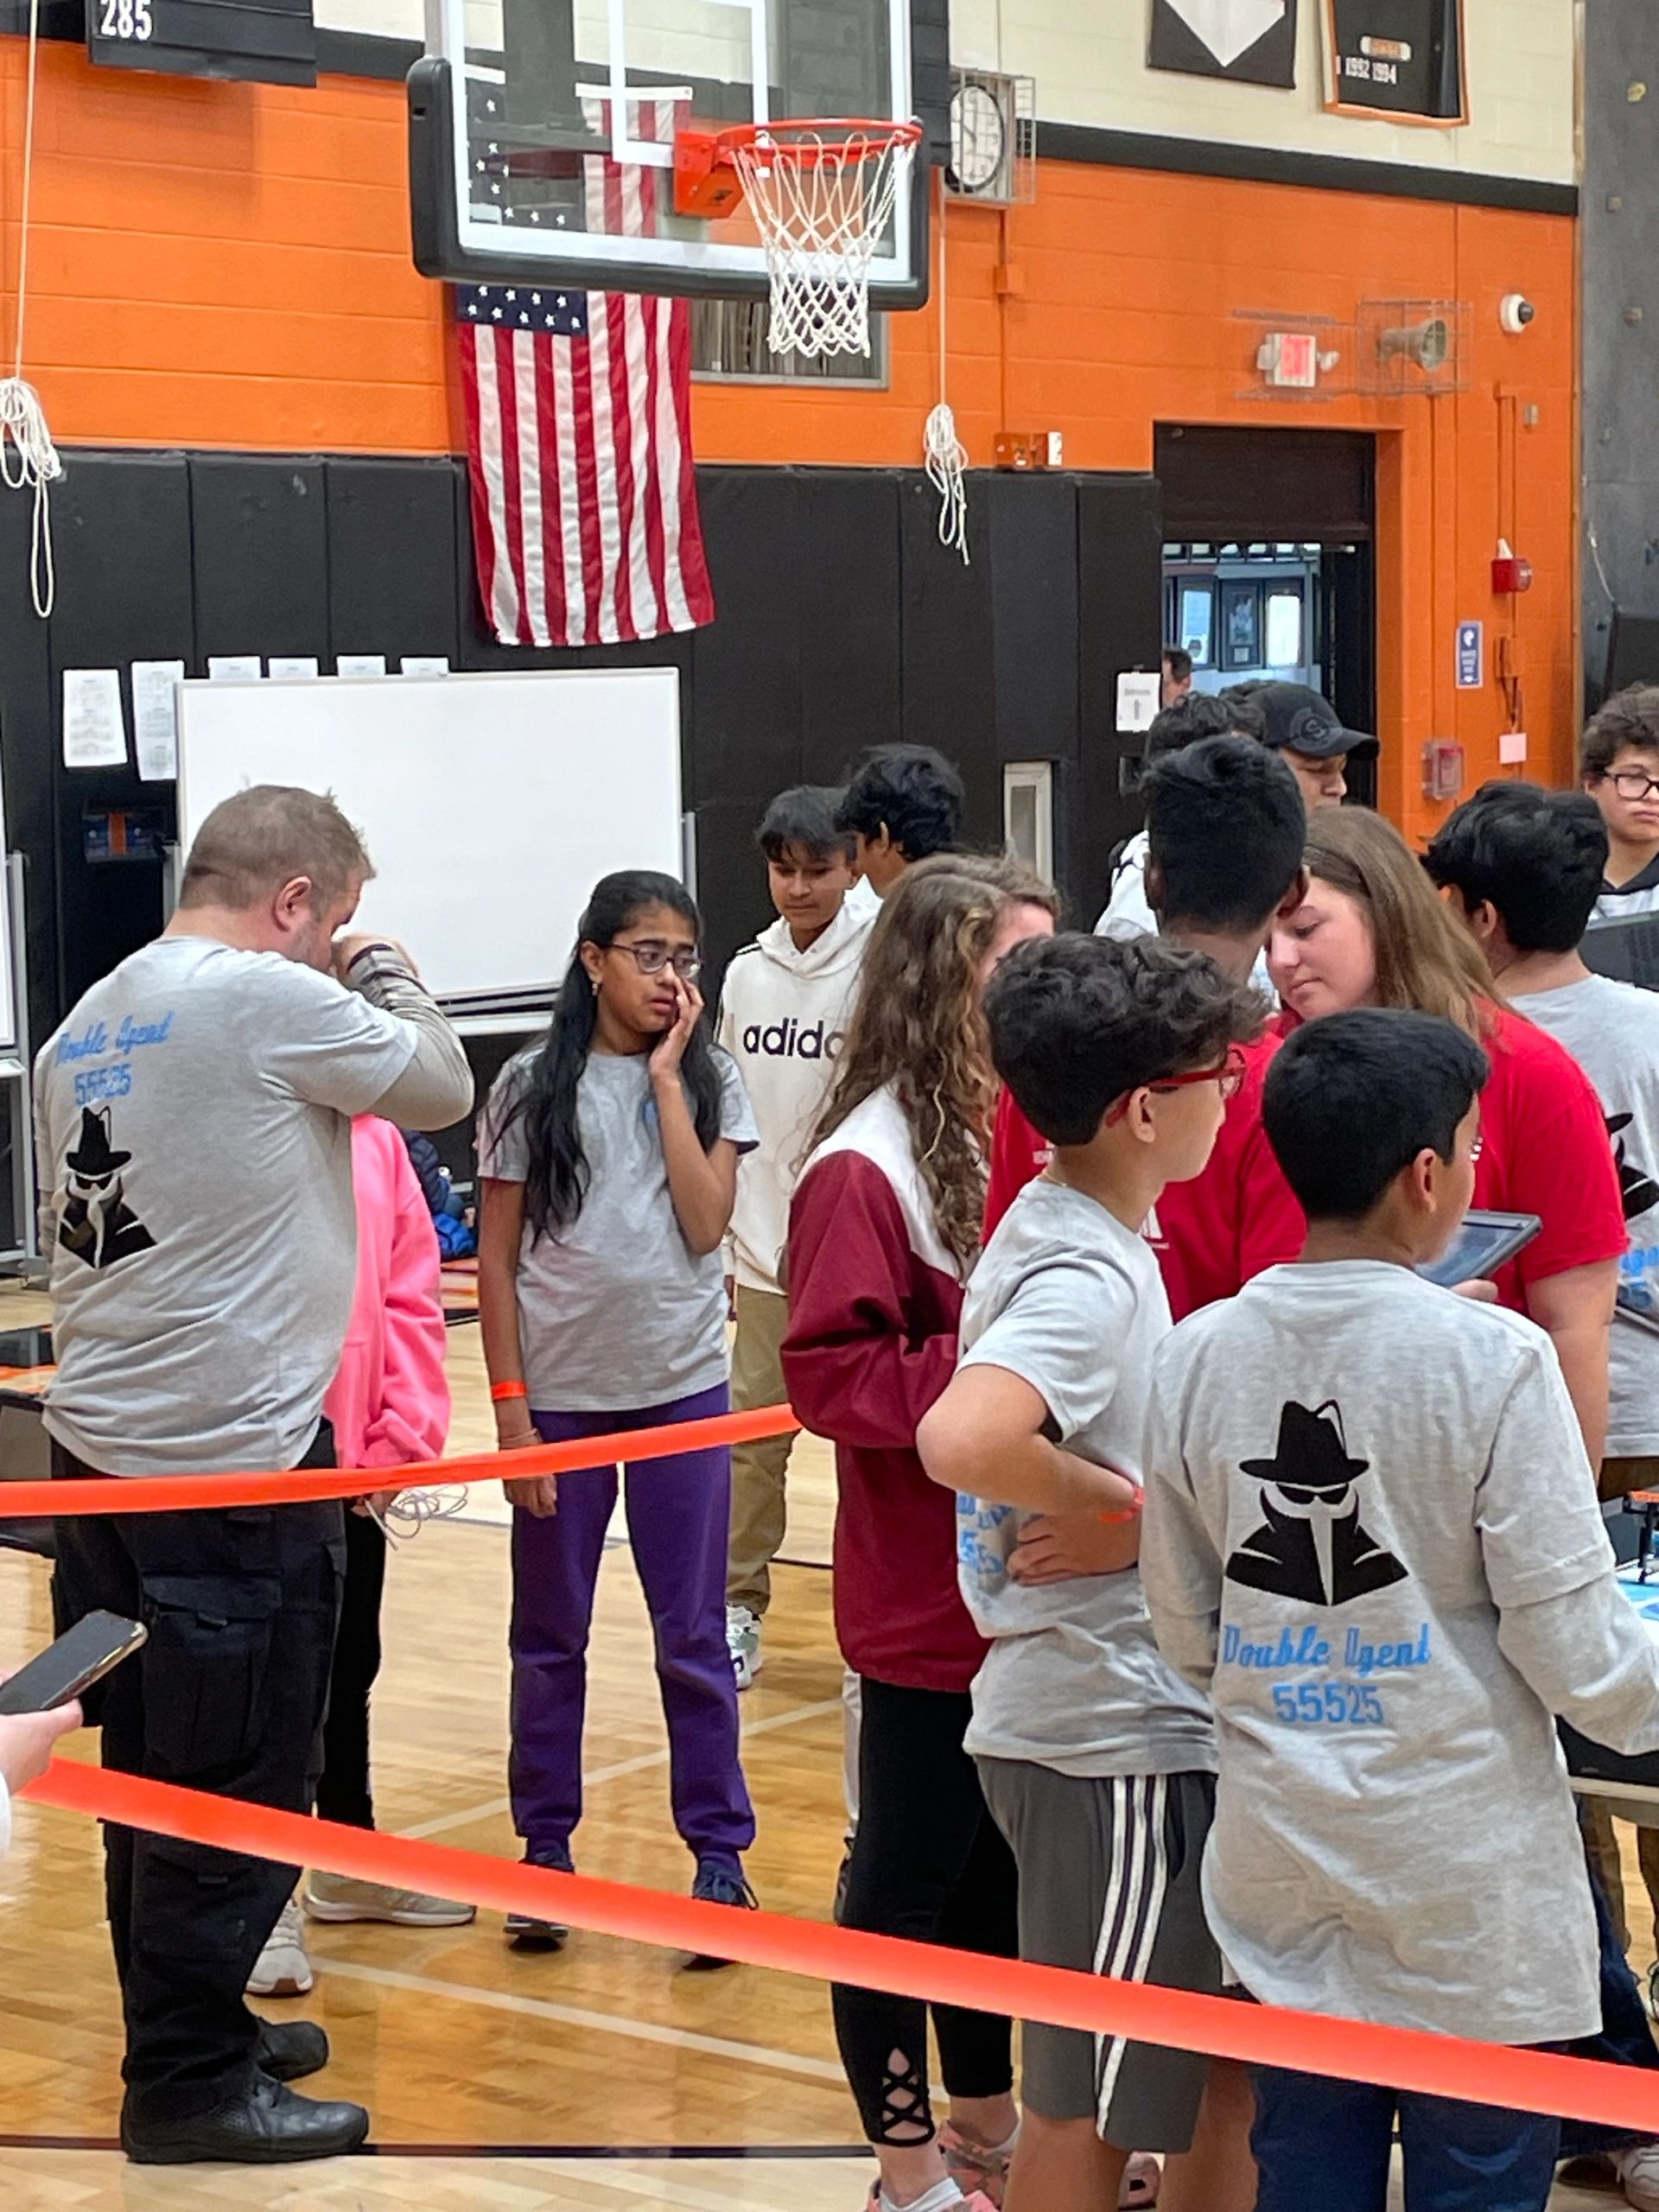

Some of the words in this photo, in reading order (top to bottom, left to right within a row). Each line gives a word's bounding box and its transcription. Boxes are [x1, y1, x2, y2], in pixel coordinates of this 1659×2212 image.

[100, 0, 152, 41] 285
[743, 1017, 848, 1059] adida
[1223, 1624, 1331, 1668] Double
[1344, 1623, 1432, 1677] Agent
[1272, 1683, 1384, 1724] 55525
